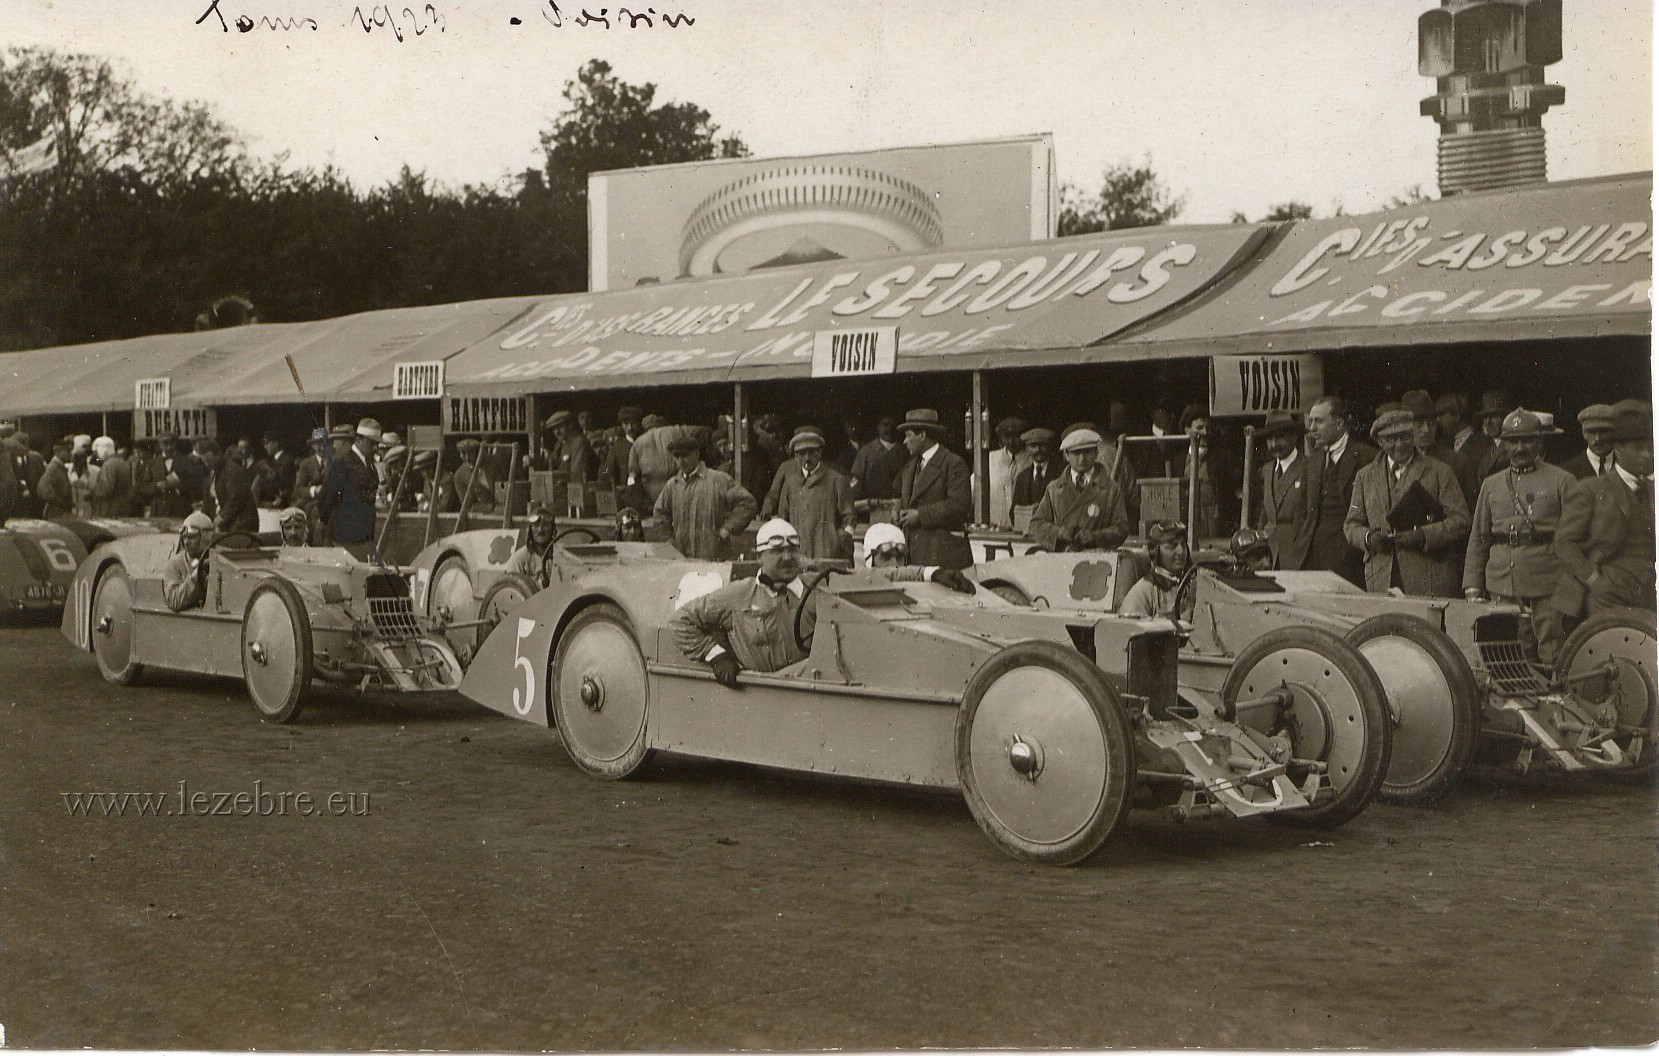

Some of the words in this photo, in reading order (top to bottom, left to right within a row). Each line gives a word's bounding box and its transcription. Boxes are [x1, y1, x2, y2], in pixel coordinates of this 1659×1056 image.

[743, 271, 862, 332] LE
[832, 243, 1197, 320] SECOURS
[831, 330, 879, 373] VOISIN
[1239, 360, 1300, 412] VOISIN
[144, 408, 208, 437] BUGATTI
[450, 397, 527, 432] HARTFORD
[39, 538, 78, 572] 6
[74, 576, 90, 649] 10
[512, 616, 536, 716] 5
